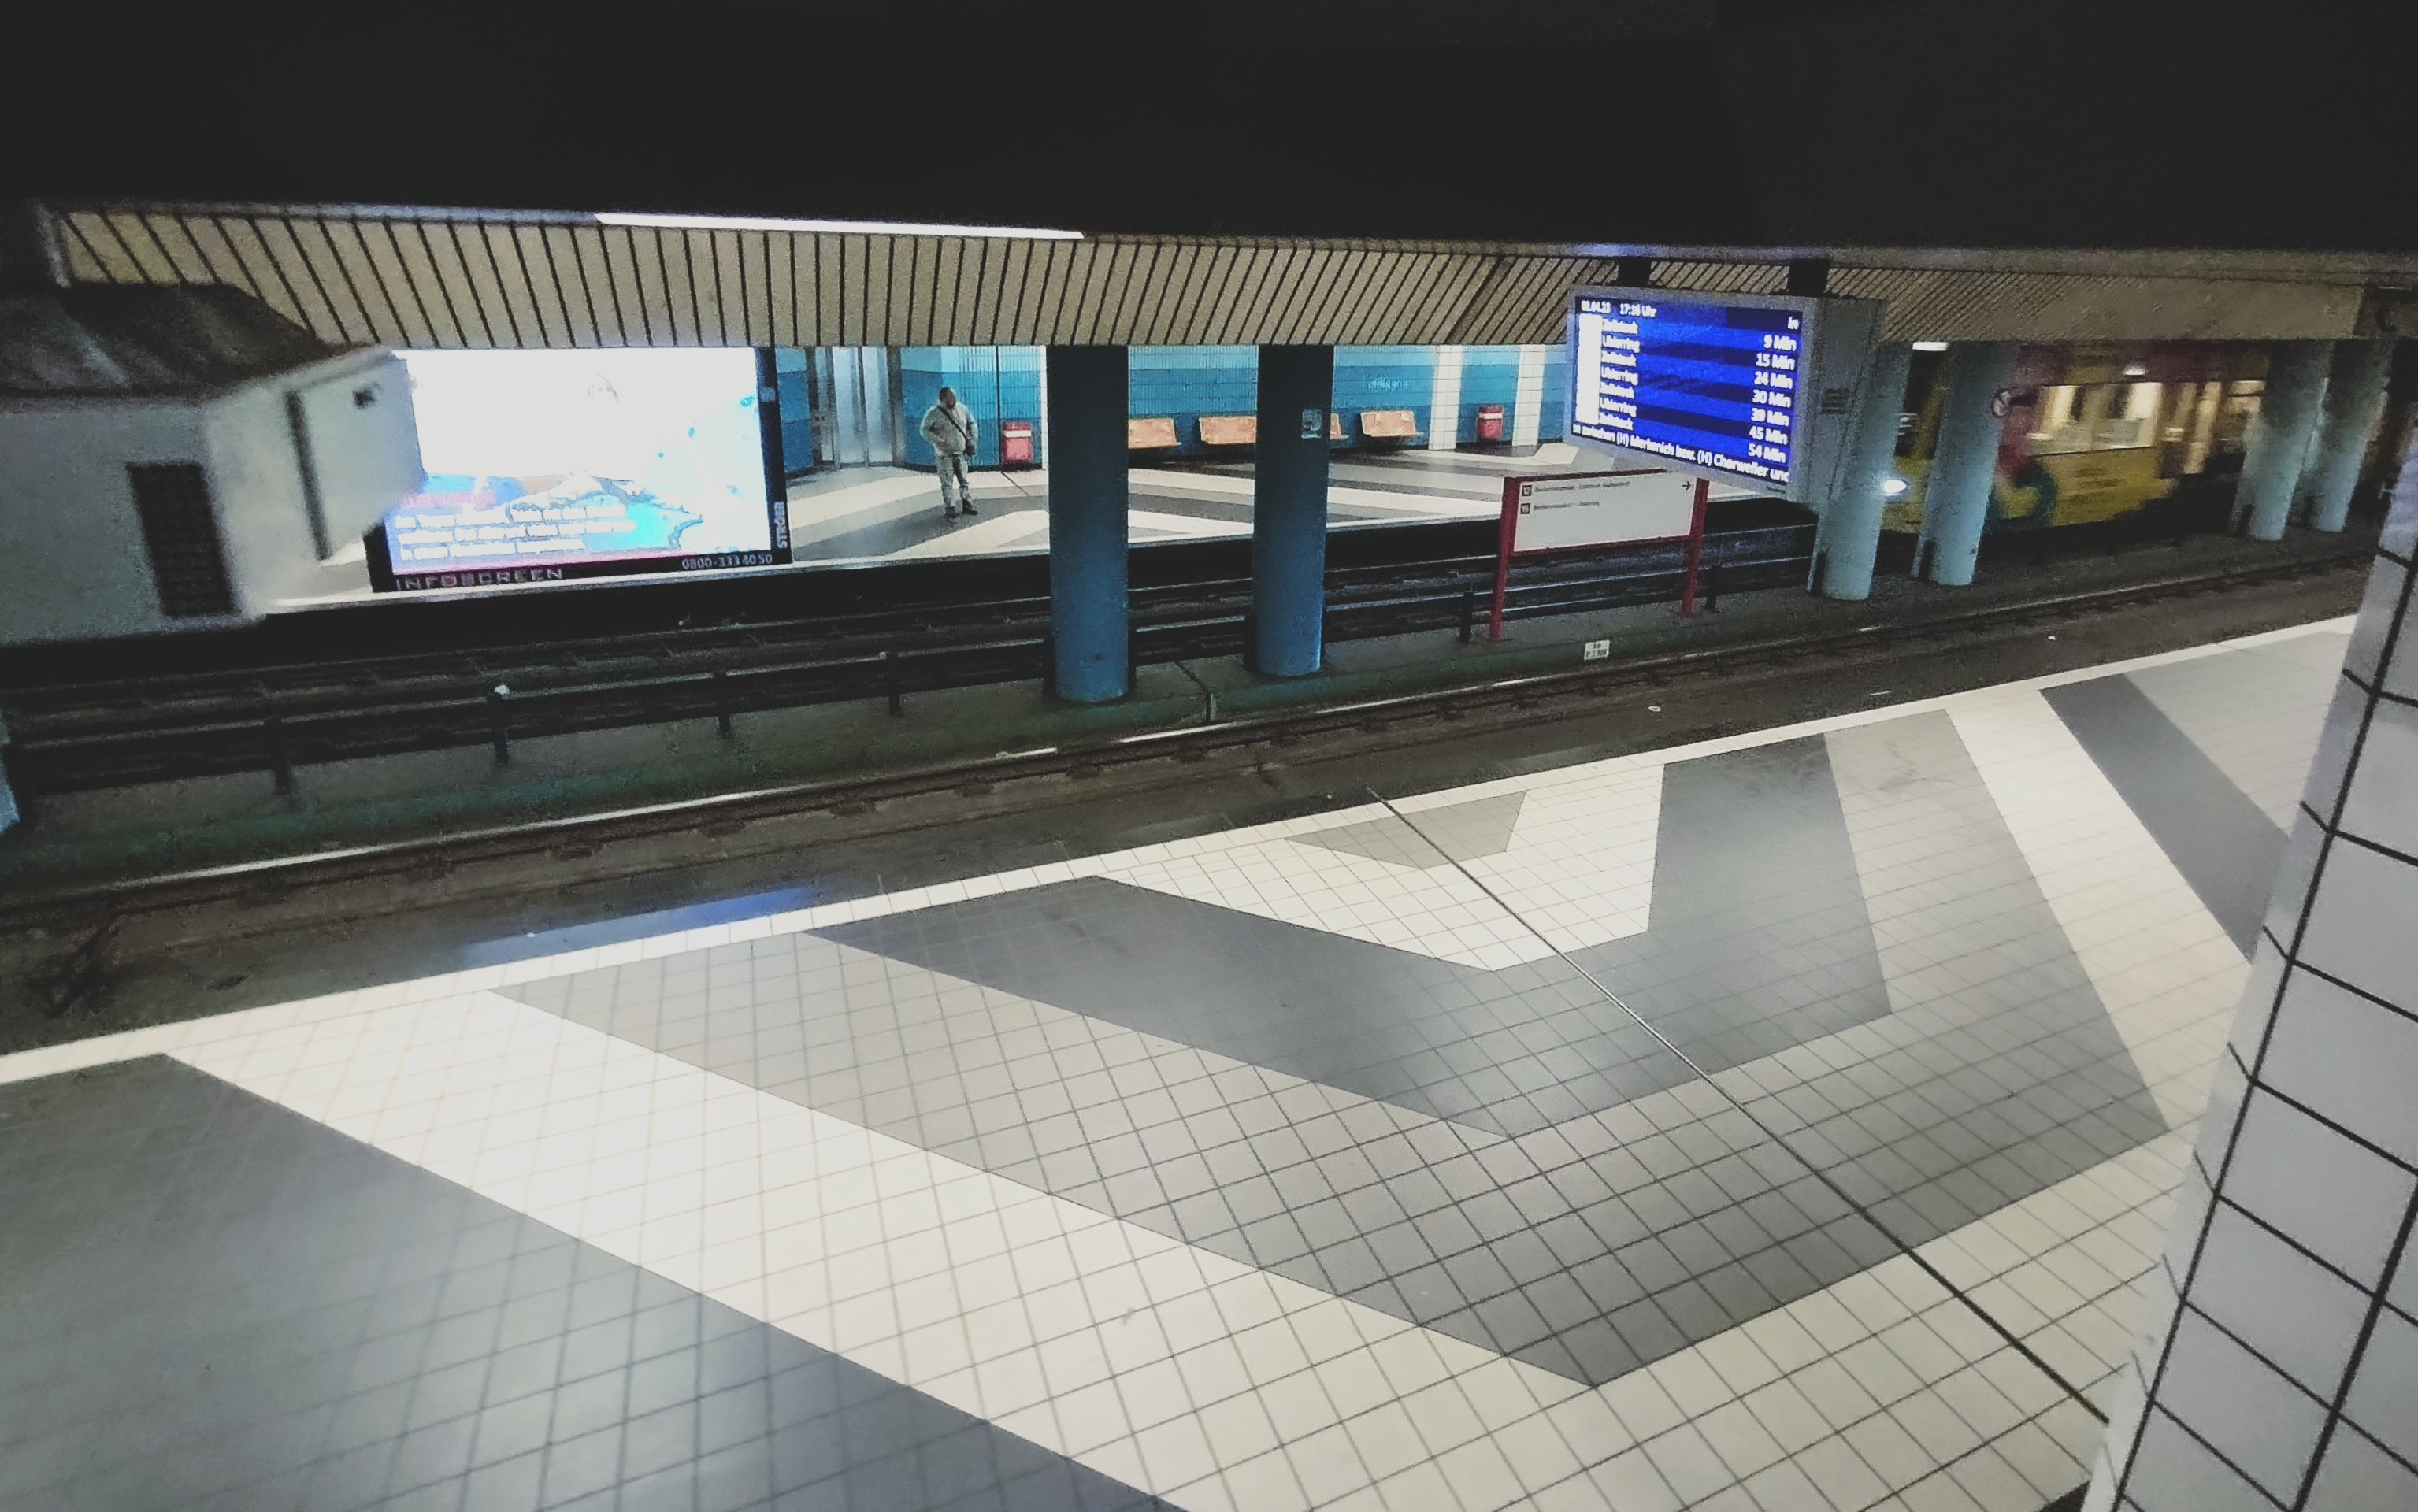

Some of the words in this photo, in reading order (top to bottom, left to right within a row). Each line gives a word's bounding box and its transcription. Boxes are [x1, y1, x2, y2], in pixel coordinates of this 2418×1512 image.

[1641, 305, 1657, 317] Uhr
[1787, 316, 1799, 329] in
[1763, 334, 1773, 349] 9
[1773, 335, 1797, 351] Min
[1756, 352, 1771, 367] 15
[1771, 354, 1796, 371] Min
[1753, 370, 1769, 386] 24
[1770, 372, 1793, 390] Min
[1752, 389, 1767, 404] 30
[1768, 391, 1792, 408] Min
[1750, 407, 1766, 422] 39
[1766, 410, 1789, 427] Min
[1749, 425, 1764, 440] 45
[1764, 428, 1788, 446] Min
[1616, 431, 1630, 447] (H)
[1630, 434, 1674, 456] Merkenich
[1697, 449, 1712, 467] (H)
[1713, 453, 1769, 478] Chorweiler
[1748, 443, 1763, 458] 54
[1763, 446, 1786, 464] Min
